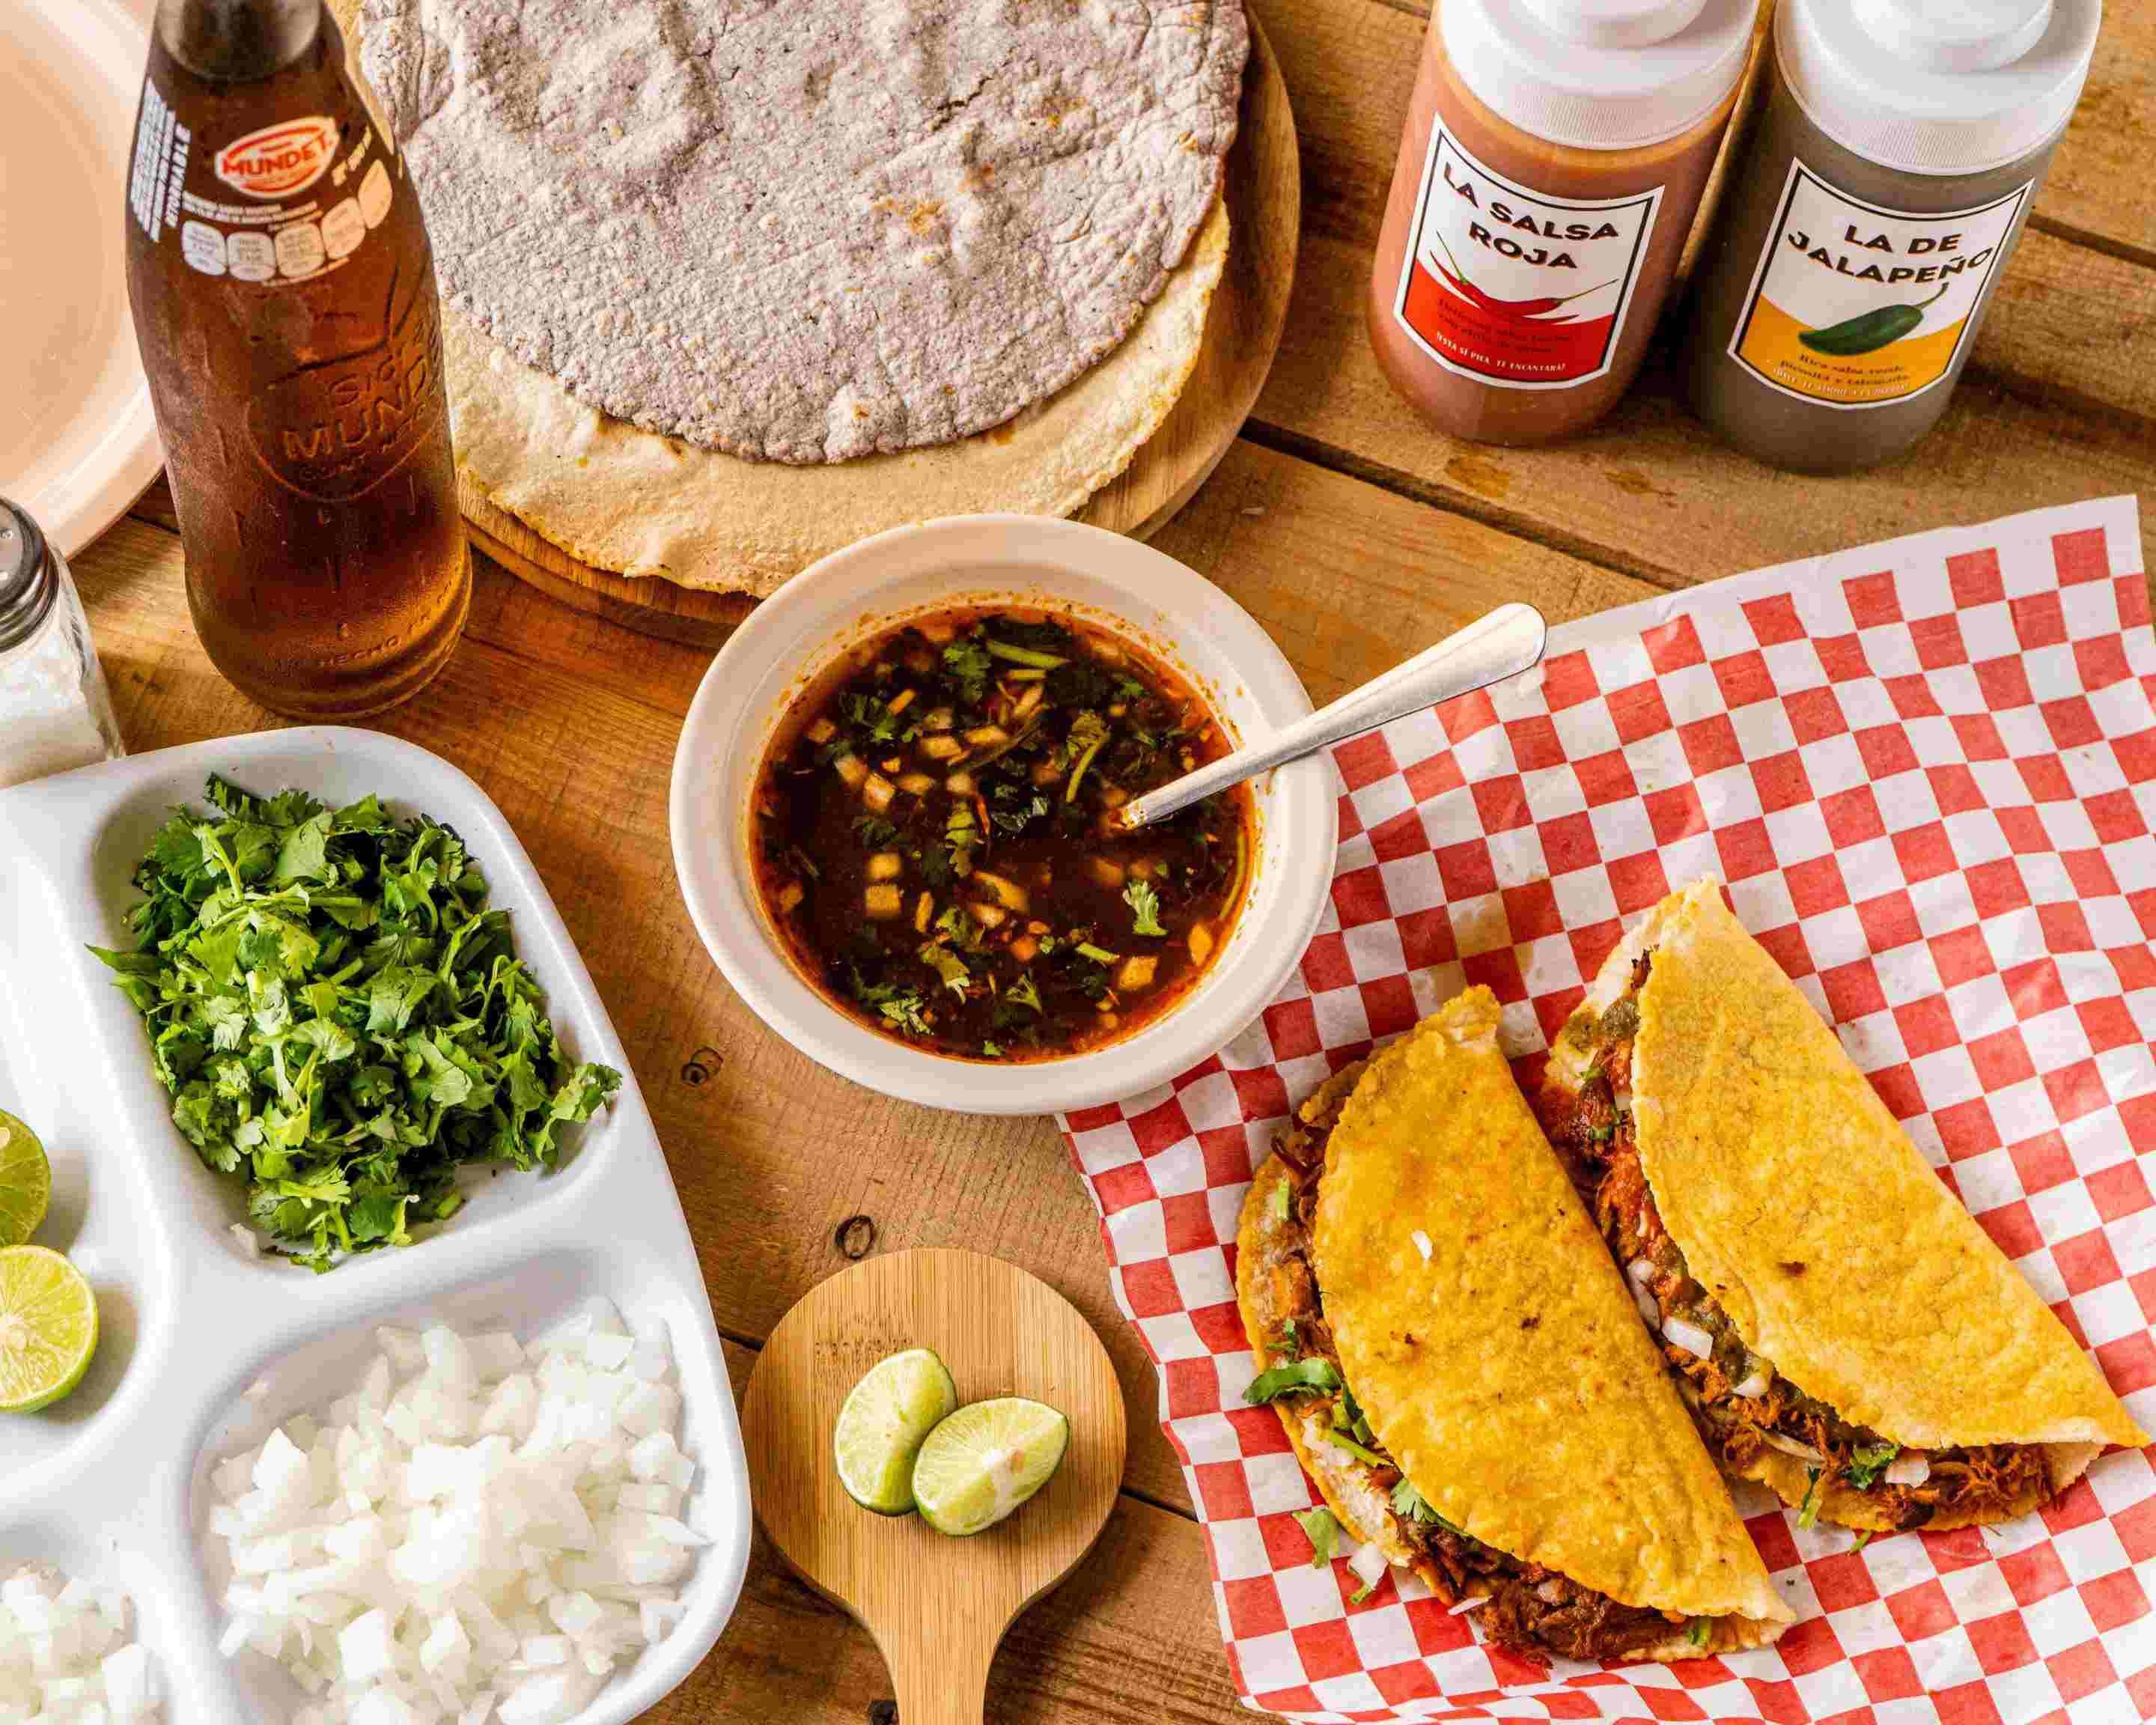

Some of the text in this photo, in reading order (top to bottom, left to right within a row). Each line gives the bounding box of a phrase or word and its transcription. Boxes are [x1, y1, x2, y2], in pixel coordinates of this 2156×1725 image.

[222, 129, 329, 174] MUNDET
[1443, 161, 1619, 241] LA SALSA
[1468, 221, 1578, 269] ROJA
[1788, 231, 1994, 284] JALAPEÑO
[1845, 225, 1963, 255] LA DE
